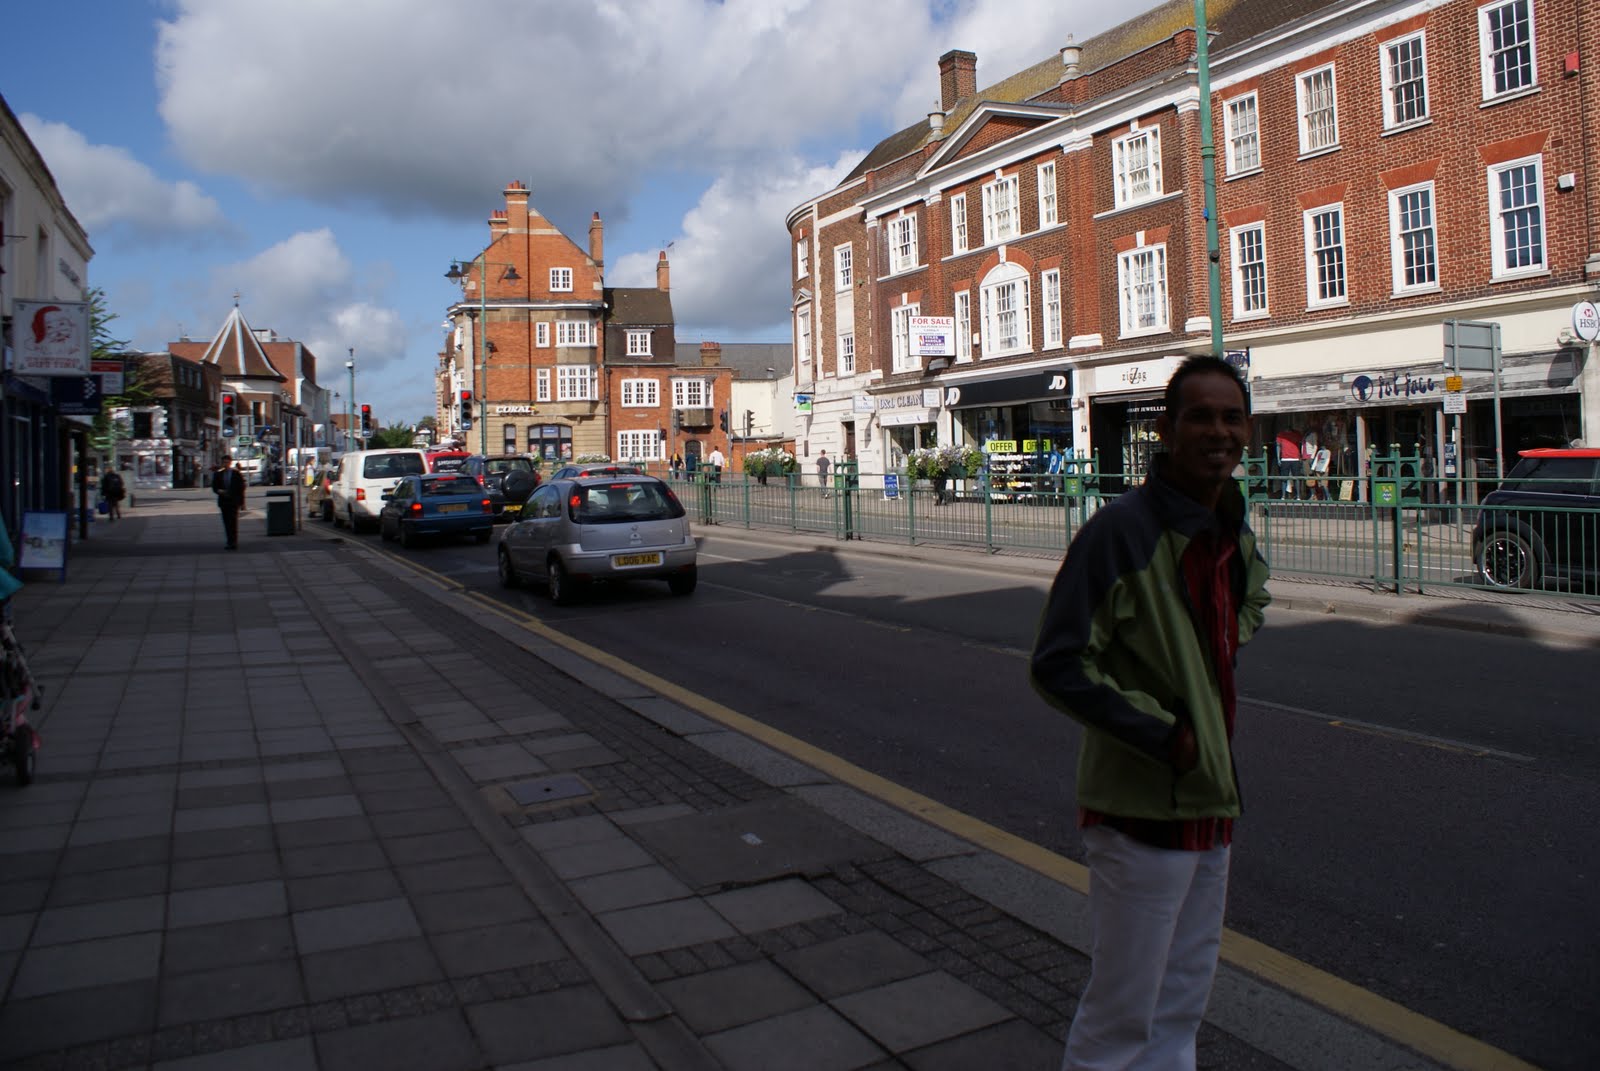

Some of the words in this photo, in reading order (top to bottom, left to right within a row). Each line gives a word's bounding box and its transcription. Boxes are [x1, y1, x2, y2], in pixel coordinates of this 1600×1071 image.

[1580, 318, 1598, 329] HSBC
[1048, 375, 1066, 390] JD
[897, 393, 922, 408] CLEAN
[945, 387, 961, 406] JD
[496, 405, 531, 413] CORAL
[990, 442, 1013, 452] OFFER
[1026, 441, 1048, 451] OFFR
